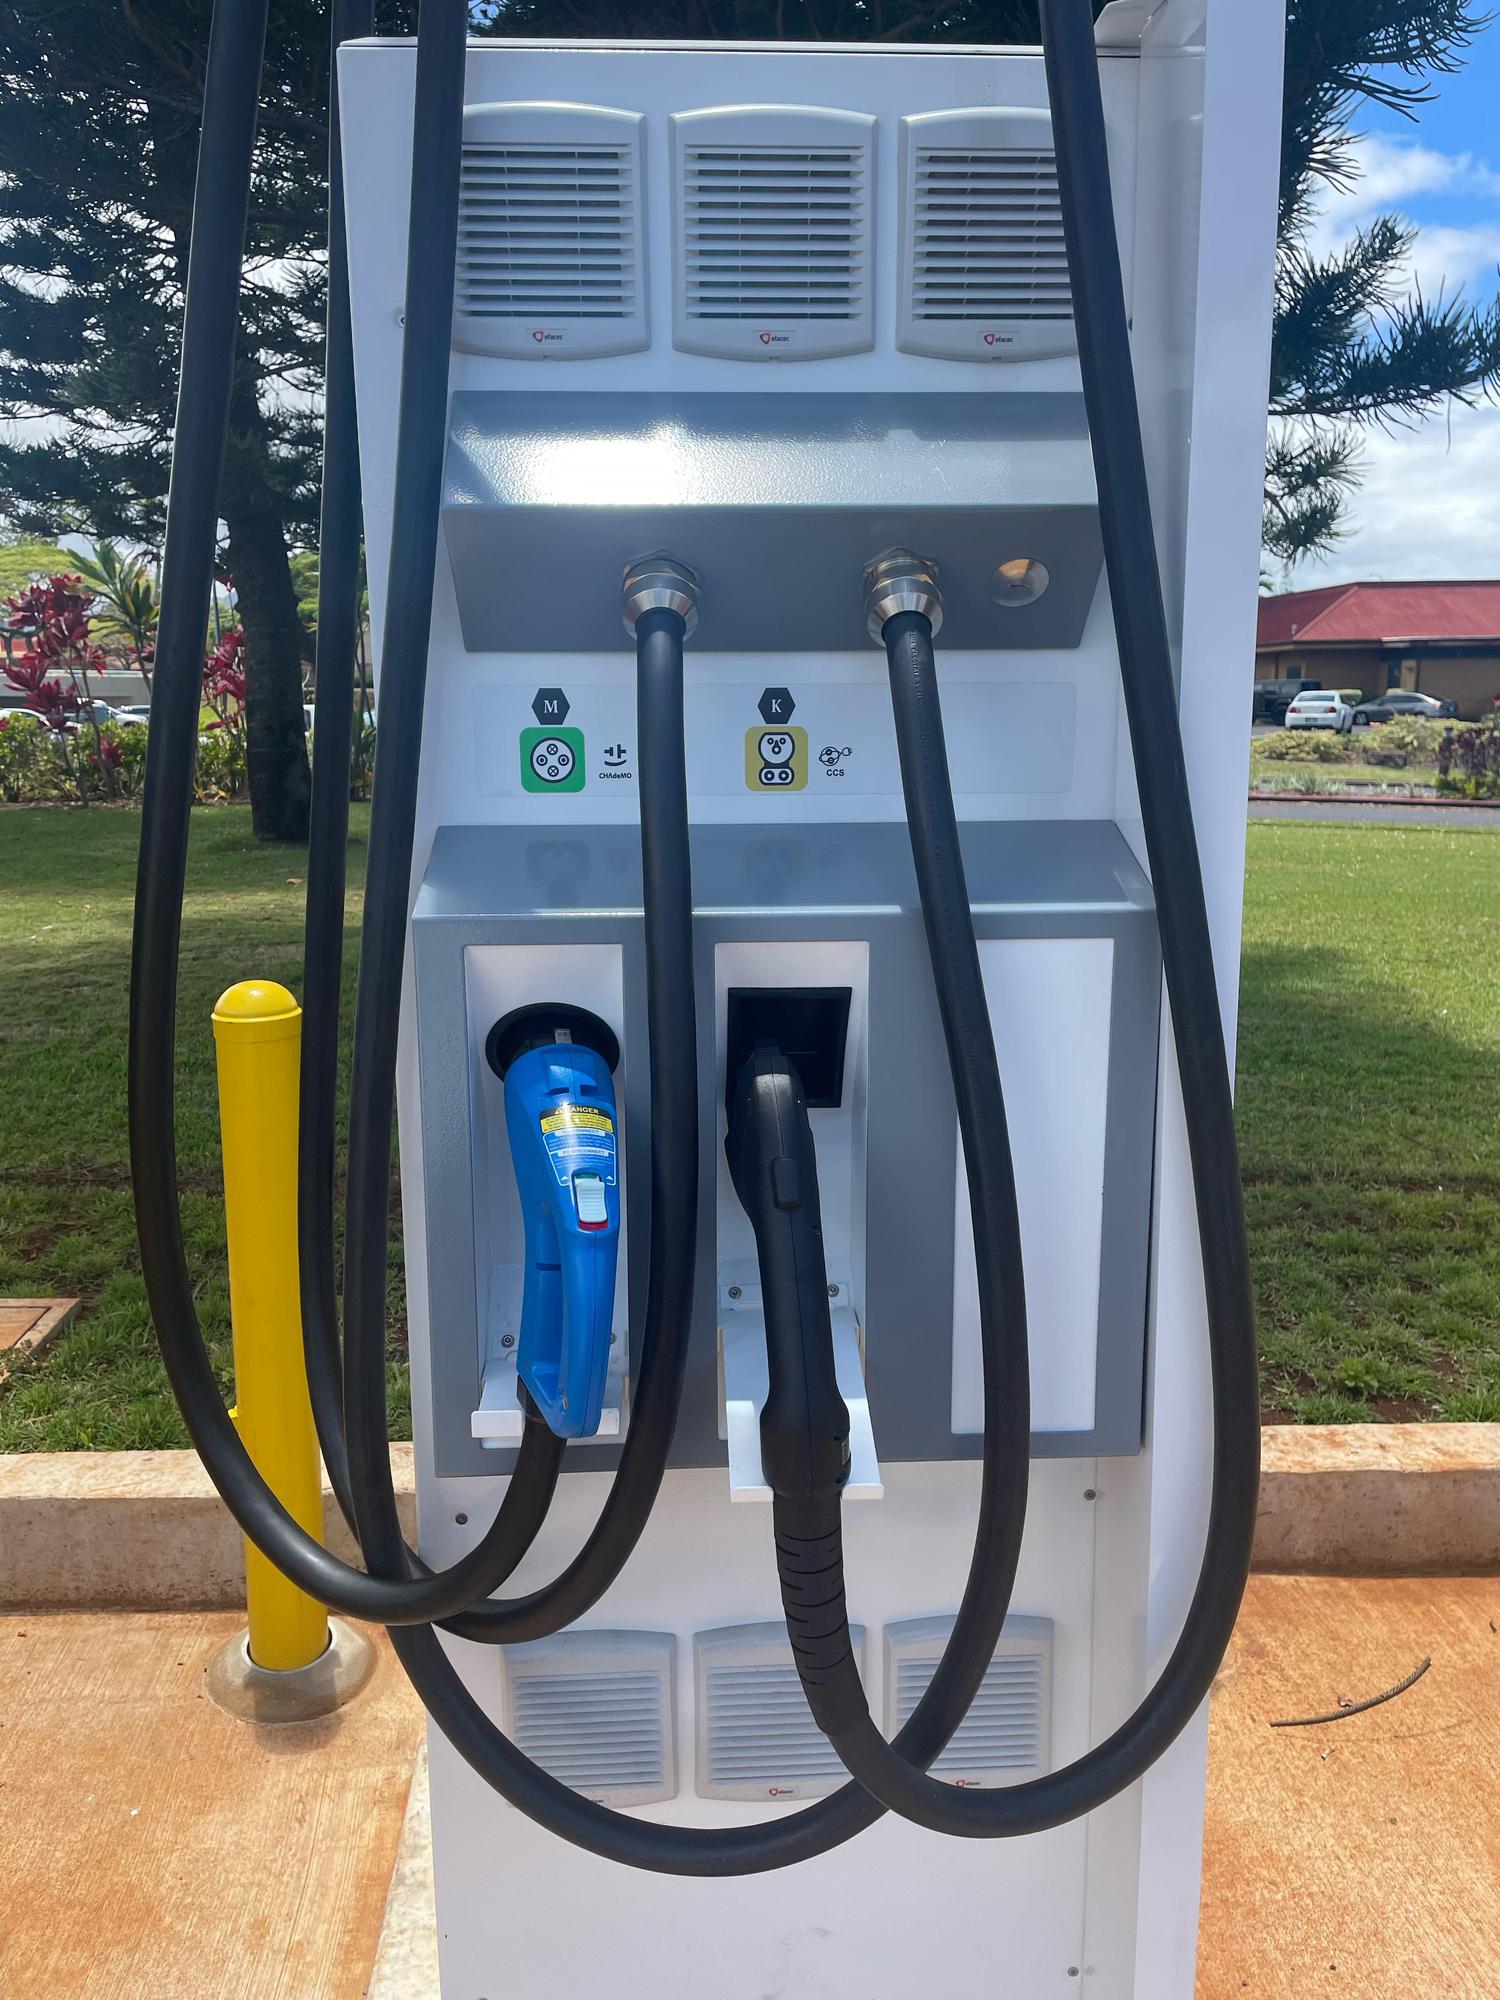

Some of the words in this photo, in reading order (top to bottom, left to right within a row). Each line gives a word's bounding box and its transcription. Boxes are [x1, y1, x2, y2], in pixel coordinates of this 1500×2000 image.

[543, 700, 559, 714] M
[771, 699, 782, 713] K
[826, 769, 845, 777] CCS
[565, 1106, 599, 1115] ANGER
